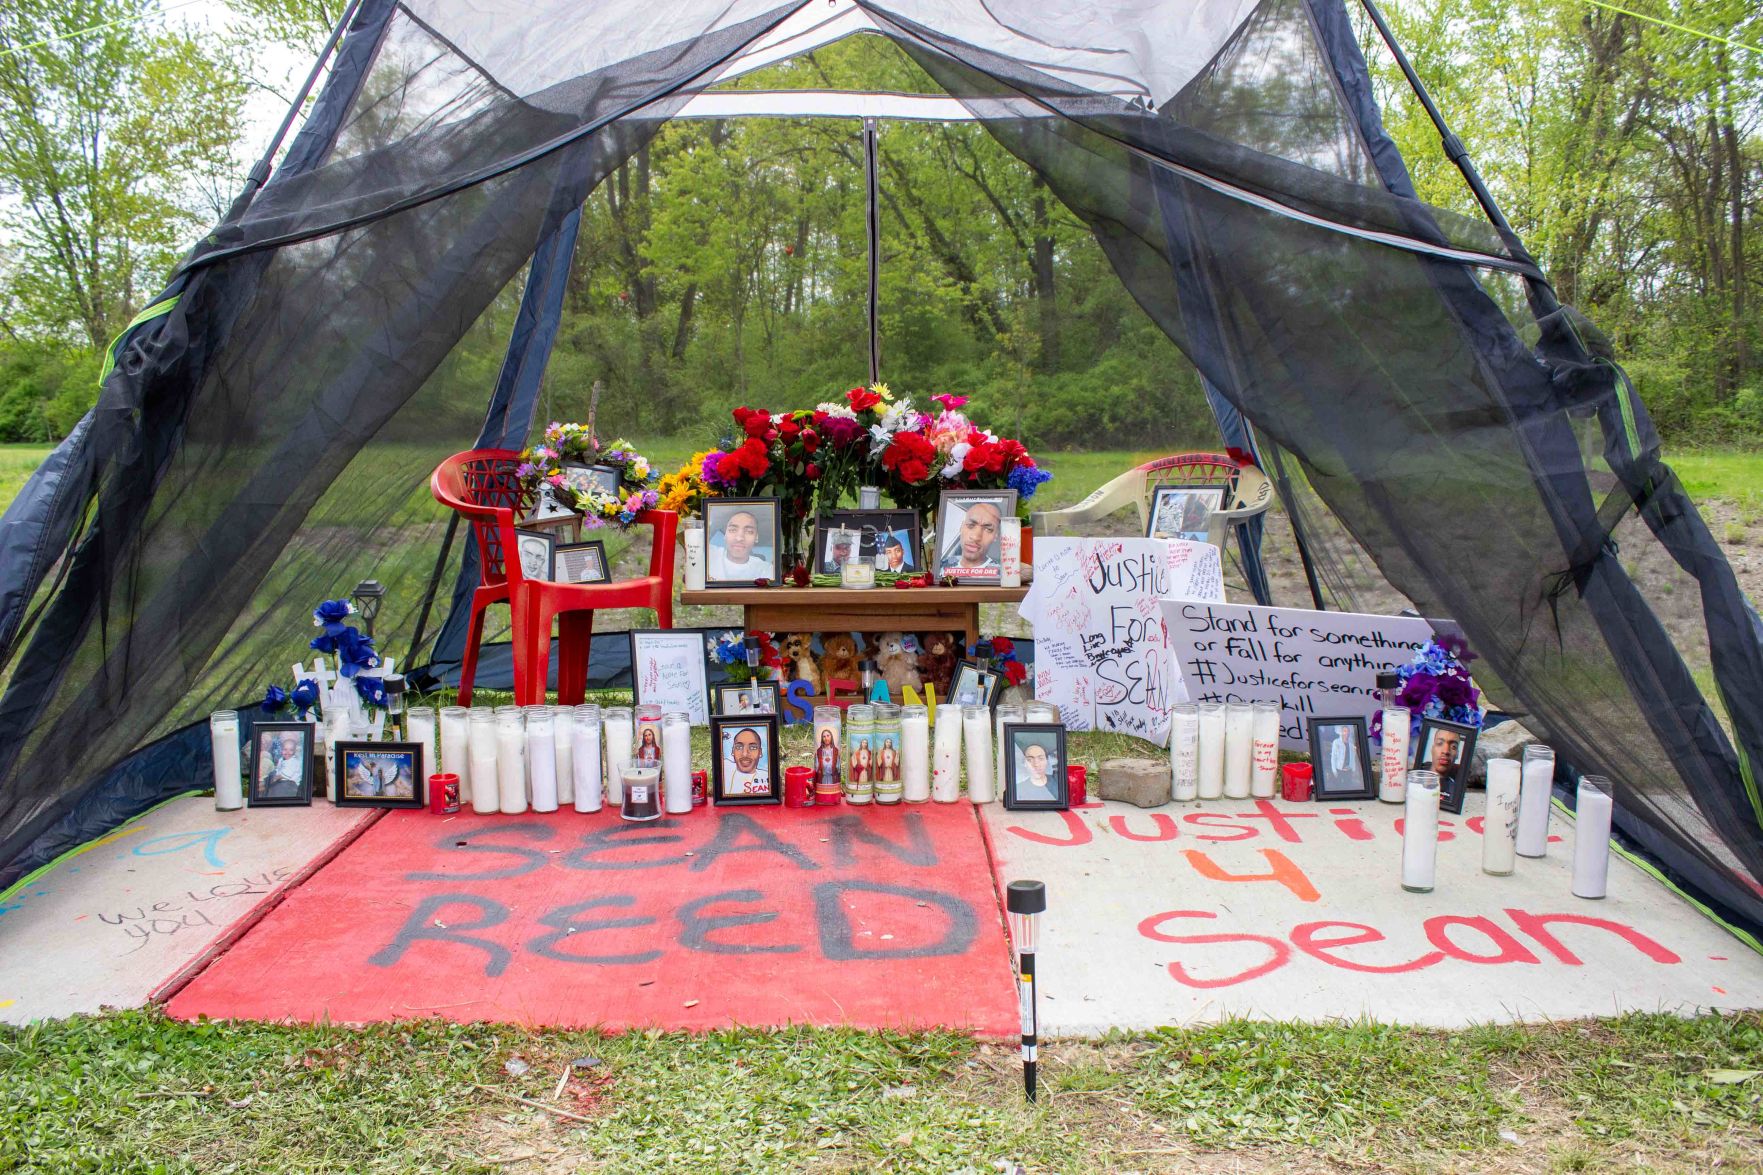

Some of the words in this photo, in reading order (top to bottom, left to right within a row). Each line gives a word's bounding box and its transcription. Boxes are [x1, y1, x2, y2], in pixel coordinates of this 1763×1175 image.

[1089, 552, 1169, 595] Justice
[1080, 633, 1106, 645] Long
[1111, 605, 1157, 644] For
[1182, 605, 1258, 633] Stand
[1266, 614, 1303, 637] for
[1194, 641, 1217, 651] or
[1225, 637, 1267, 661] Fall
[1274, 641, 1302, 663] for
[1319, 653, 1402, 672] anythin
[1096, 658, 1170, 716] SEAN
[405, 811, 940, 882] SEAN
[1180, 848, 1322, 902] 4
[368, 880, 979, 978] REED
[1137, 907, 1682, 988] Sean
